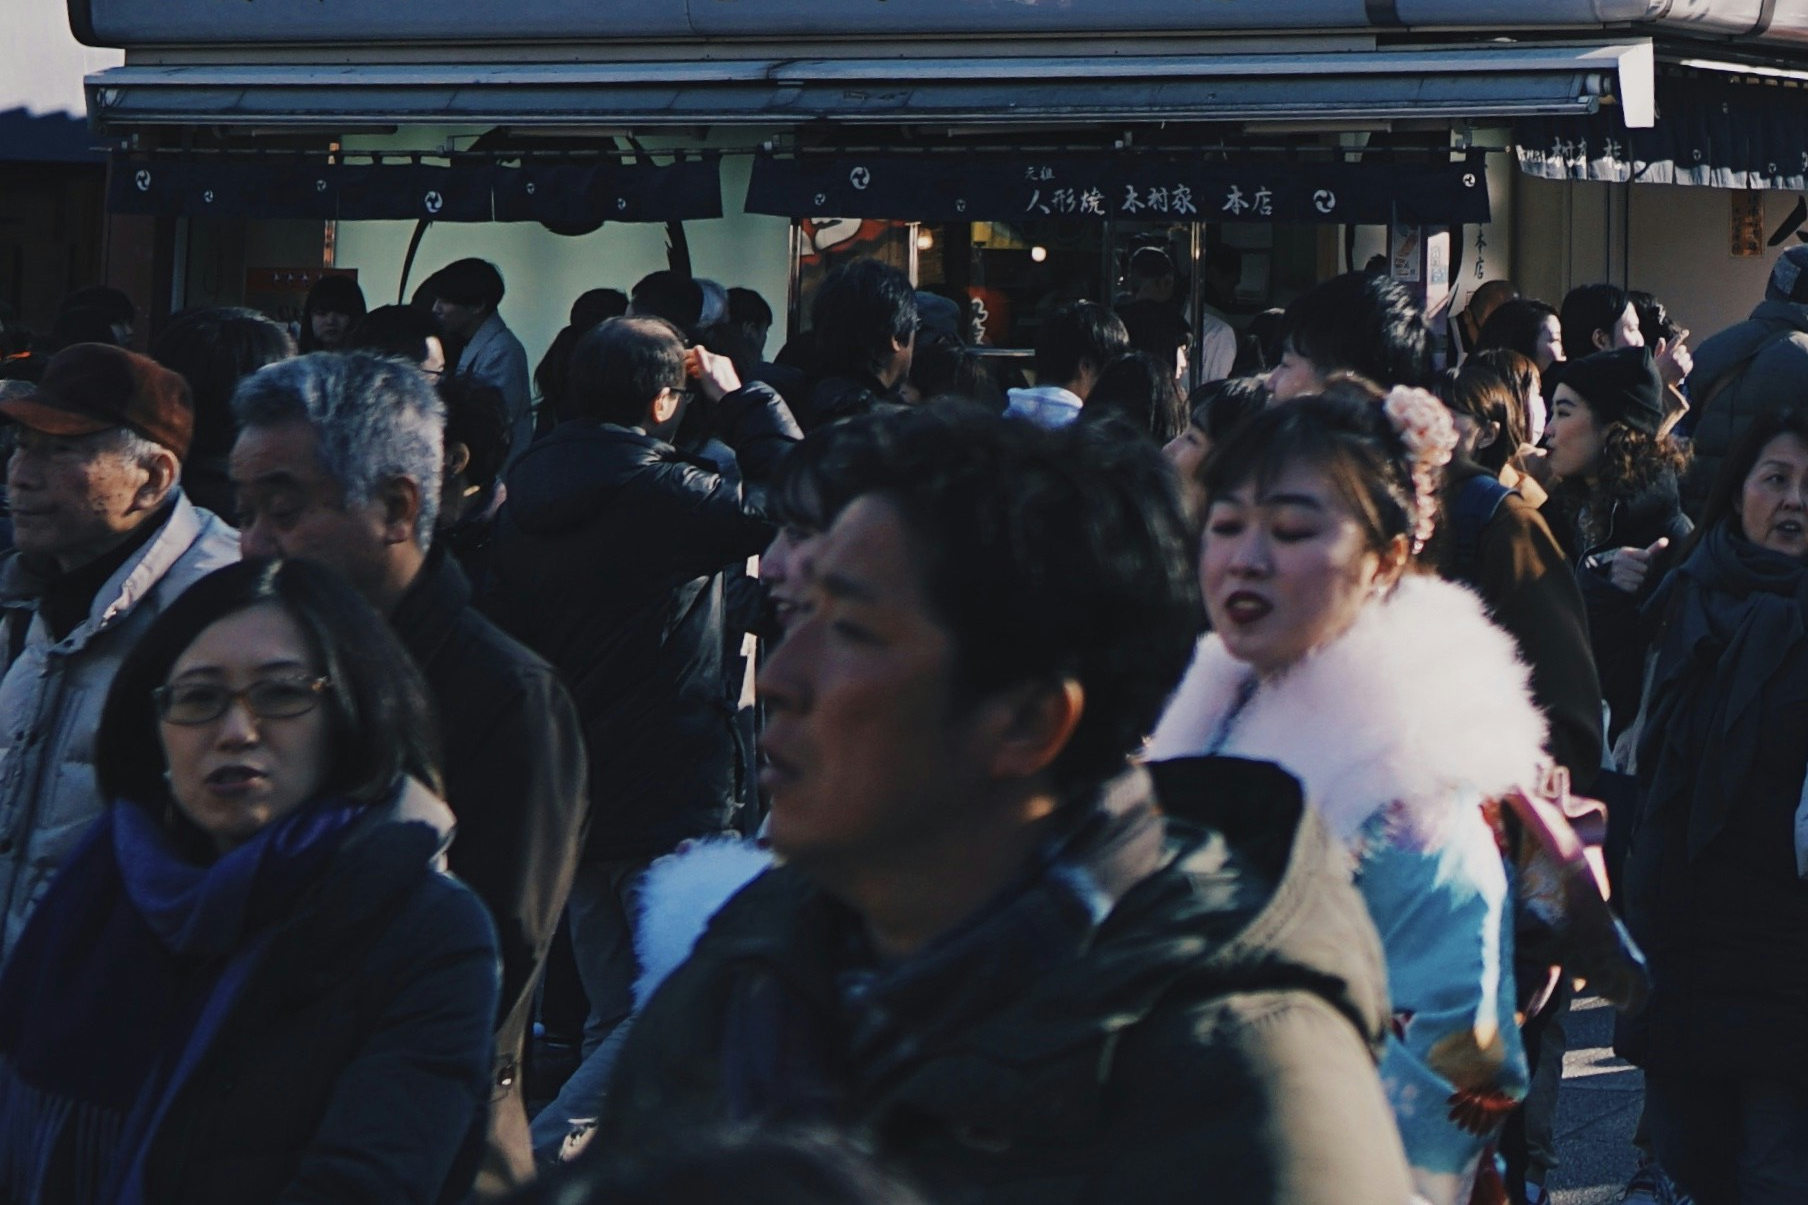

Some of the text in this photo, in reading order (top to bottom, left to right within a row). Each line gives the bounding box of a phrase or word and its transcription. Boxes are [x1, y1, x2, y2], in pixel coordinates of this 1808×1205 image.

[1024, 165, 1056, 182] 元祖
[1025, 183, 1274, 216] 人形焼 木村家 本店
